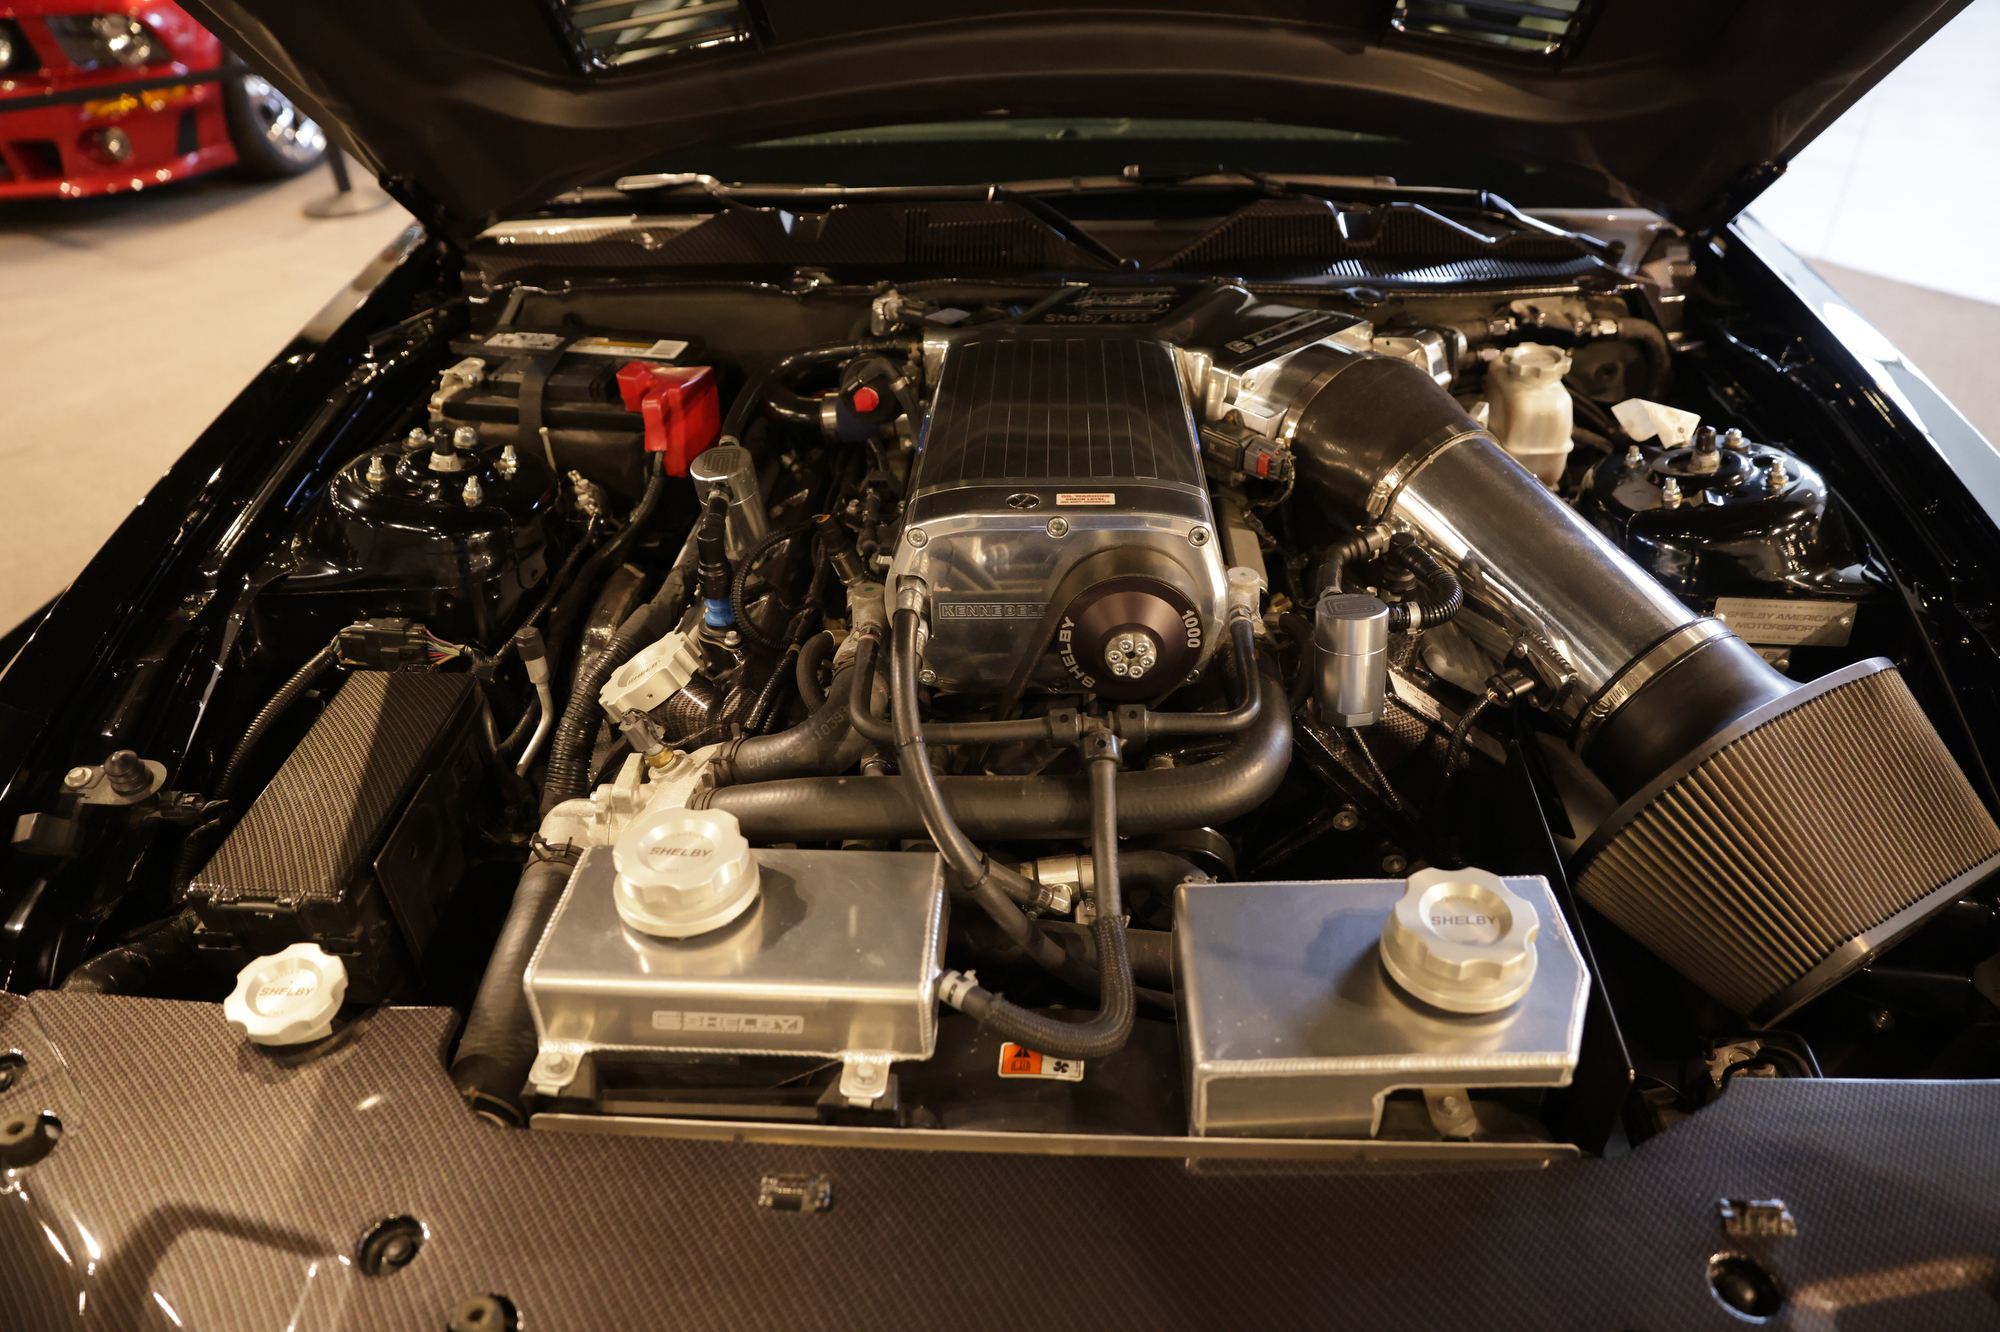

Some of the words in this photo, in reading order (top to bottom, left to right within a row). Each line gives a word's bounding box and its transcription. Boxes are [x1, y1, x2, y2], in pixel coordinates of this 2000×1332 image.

[1044, 313, 1104, 324] Shelby
[1726, 610, 1775, 620] SHELBY
[1775, 612, 1841, 622] AMERICAN
[1181, 609, 1201, 648] 1000
[1734, 621, 1828, 632] MOTORSPORTS
[1059, 616, 1096, 688] SHELBY
[648, 846, 713, 858] SHELBY
[1431, 915, 1497, 926] SHELBY
[259, 987, 315, 996] SHELBY
[683, 1013, 802, 1033] SHELBY
